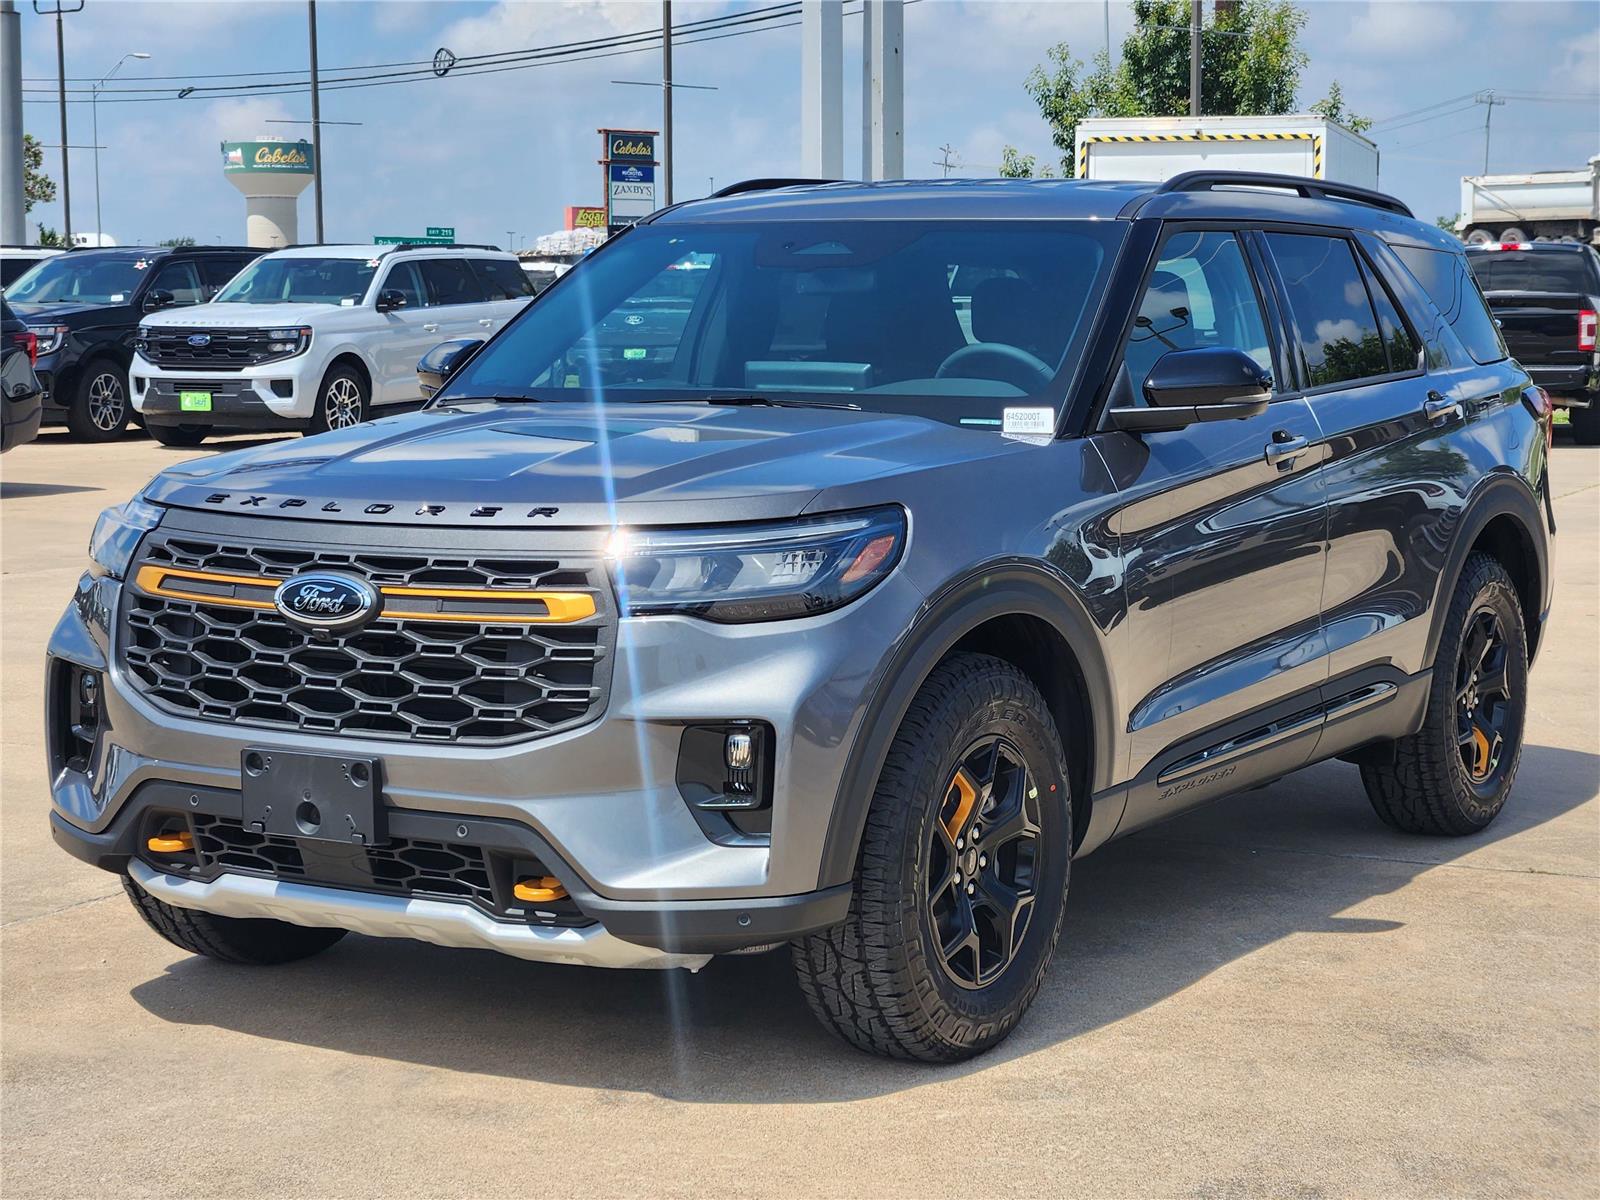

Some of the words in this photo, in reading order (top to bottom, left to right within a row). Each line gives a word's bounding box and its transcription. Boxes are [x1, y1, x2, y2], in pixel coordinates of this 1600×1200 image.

[255, 147, 305, 163] Cabela's
[613, 140, 651, 155] Cabela's
[613, 185, 652, 196] ZAXBY'S
[205, 493, 560, 518] EXPLORER
[293, 584, 346, 614] Ford
[1158, 765, 1237, 800] EXPLORER
